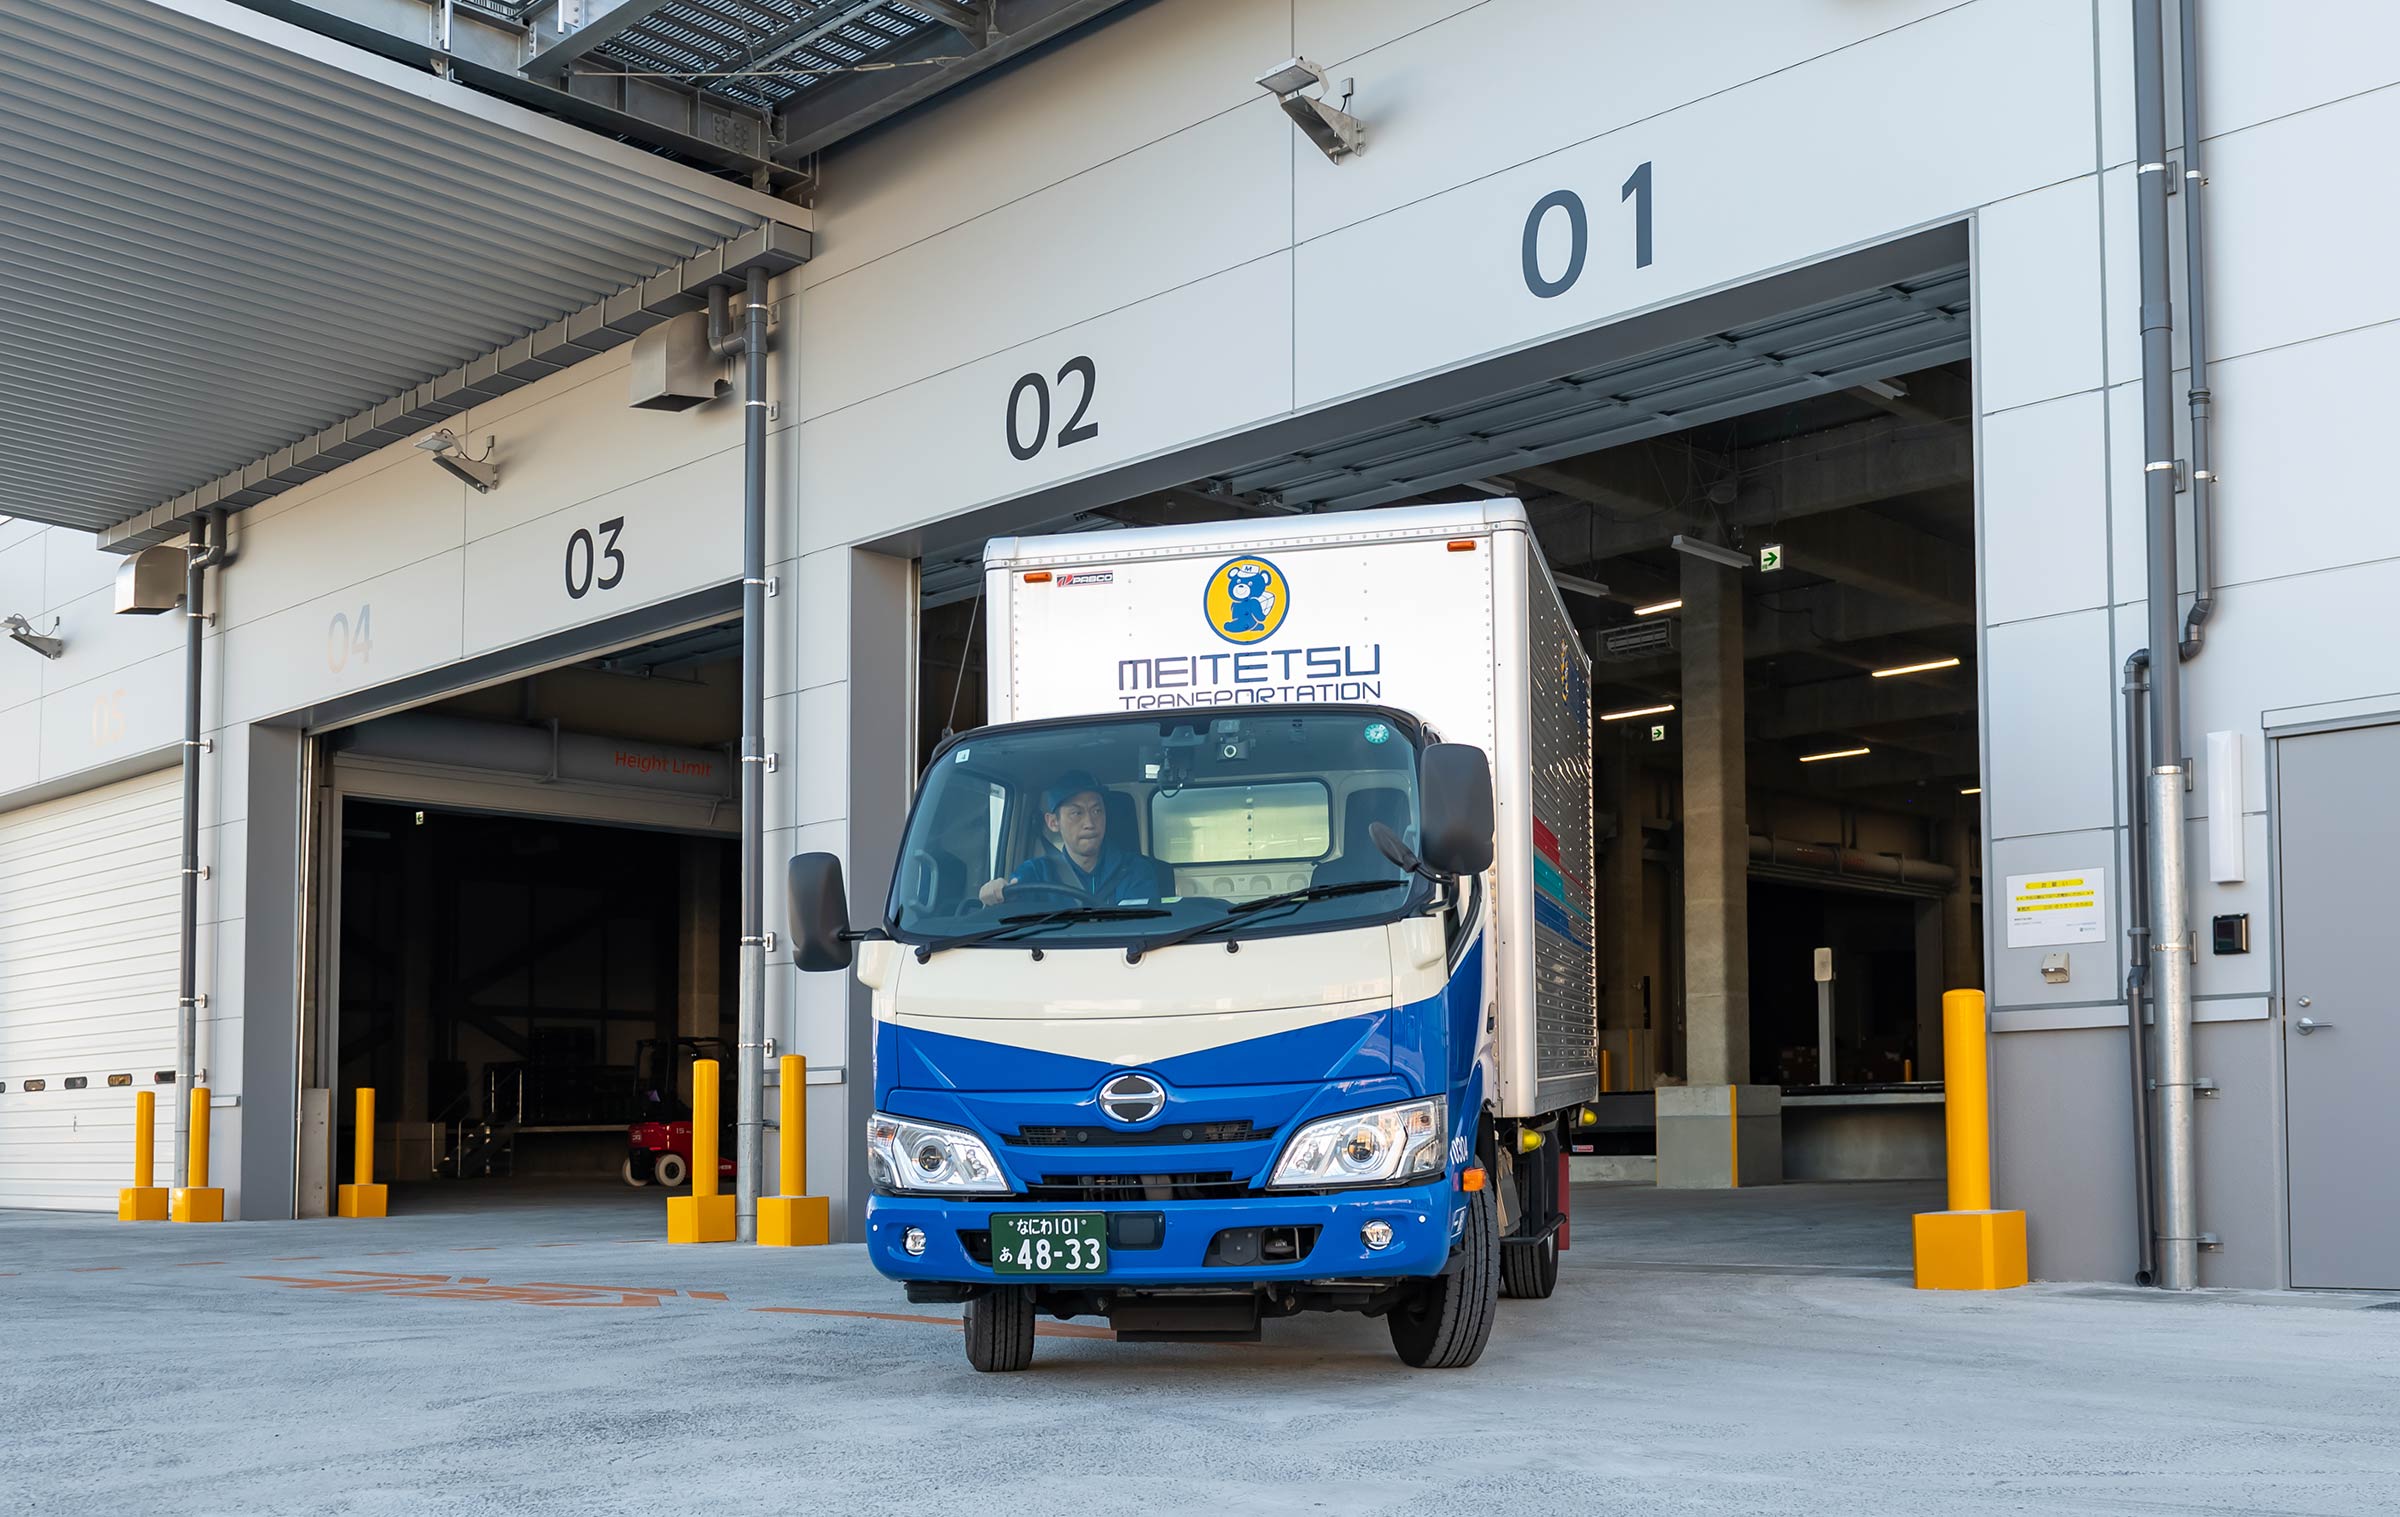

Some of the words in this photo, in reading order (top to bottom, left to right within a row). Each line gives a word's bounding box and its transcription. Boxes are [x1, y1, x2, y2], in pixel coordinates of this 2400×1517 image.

[1522, 161, 1652, 298] 01
[1006, 355, 1099, 461] 02
[565, 516, 625, 599] 03
[327, 603, 374, 673] 04
[1119, 644, 1380, 690] MEITETSU
[92, 688, 127, 747] 05
[1119, 681, 1381, 710] TRANSPORTATION
[614, 751, 667, 773] Height
[672, 758, 712, 777] Limit
[999, 1246, 1013, 1263] あ
[1017, 1238, 1101, 1270] 48-33
